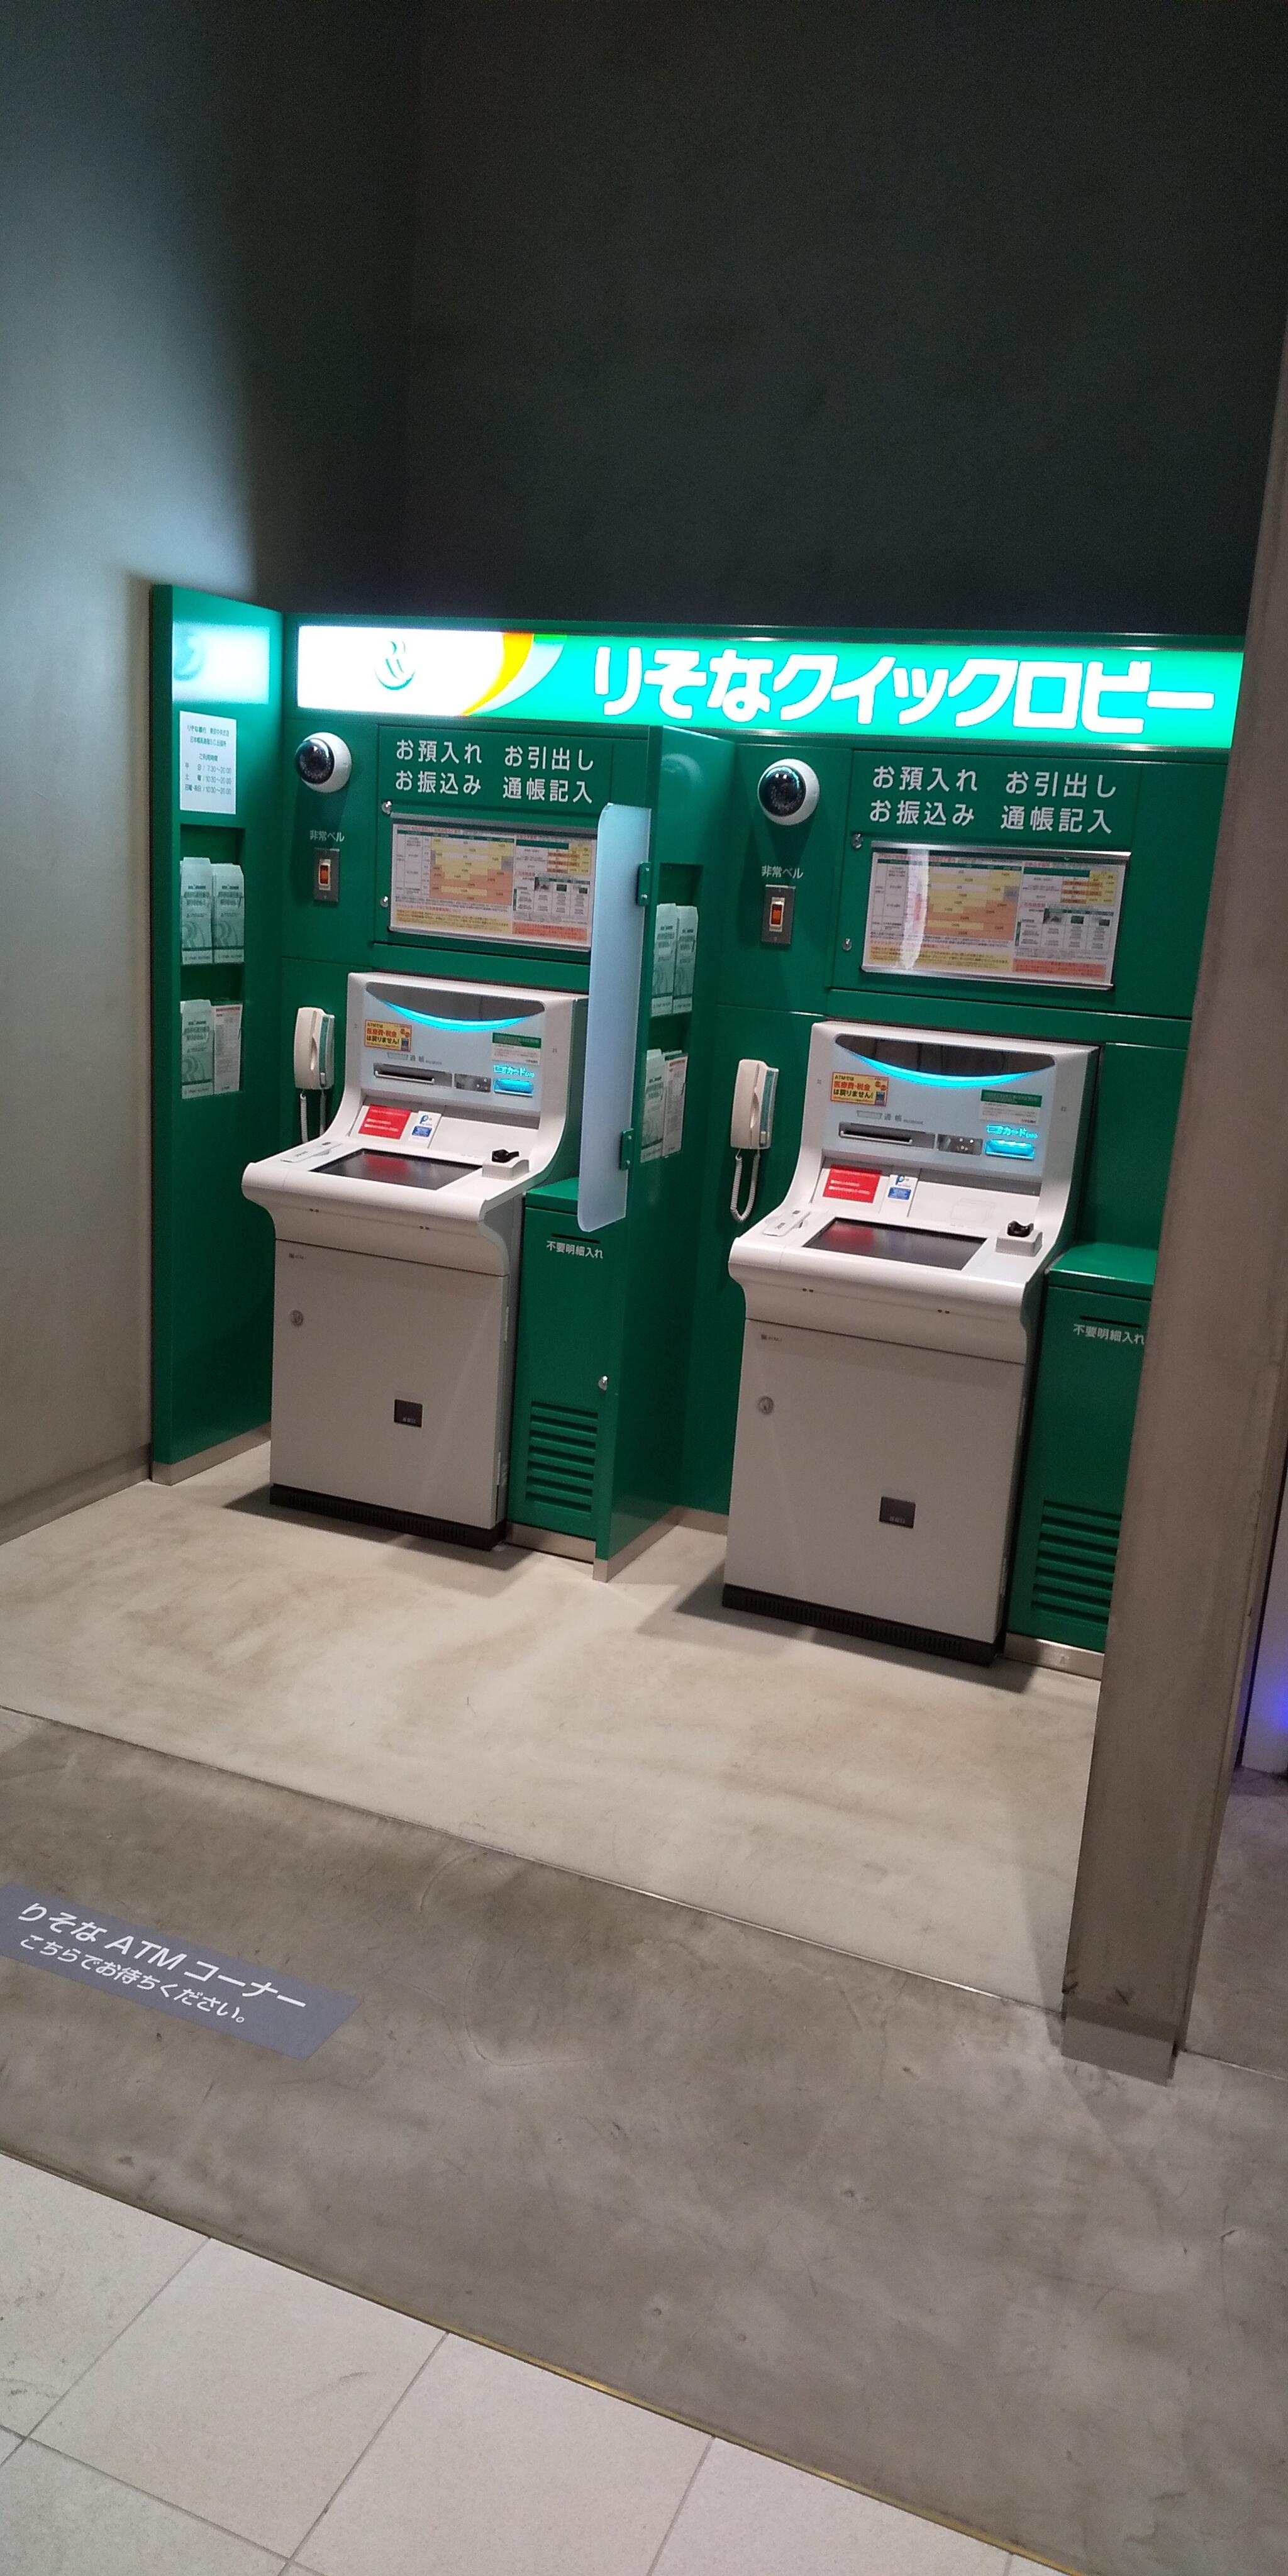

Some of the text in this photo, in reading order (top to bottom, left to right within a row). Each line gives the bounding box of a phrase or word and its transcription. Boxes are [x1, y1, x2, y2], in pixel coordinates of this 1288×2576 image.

[594, 646, 1214, 734] りそなクイックロビー
[396, 739, 594, 771] お預入れ お引出し
[395, 770, 592, 804] お振込み 通帳記入
[873, 766, 1116, 798] お預入れ お引出し
[869, 799, 1113, 834] お振込み 通帳記入
[309, 830, 345, 842] 非常ベル
[761, 865, 804, 879] 非常ベル
[833, 1088, 874, 1099] は戻りません!
[546, 1240, 604, 1260] 不要明細入れ
[1073, 1323, 1145, 1345] 不要明細入れ
[18, 1902, 306, 2008] りそな ATM コーナー
[19, 1934, 245, 2024] こちらでお待ちください。
